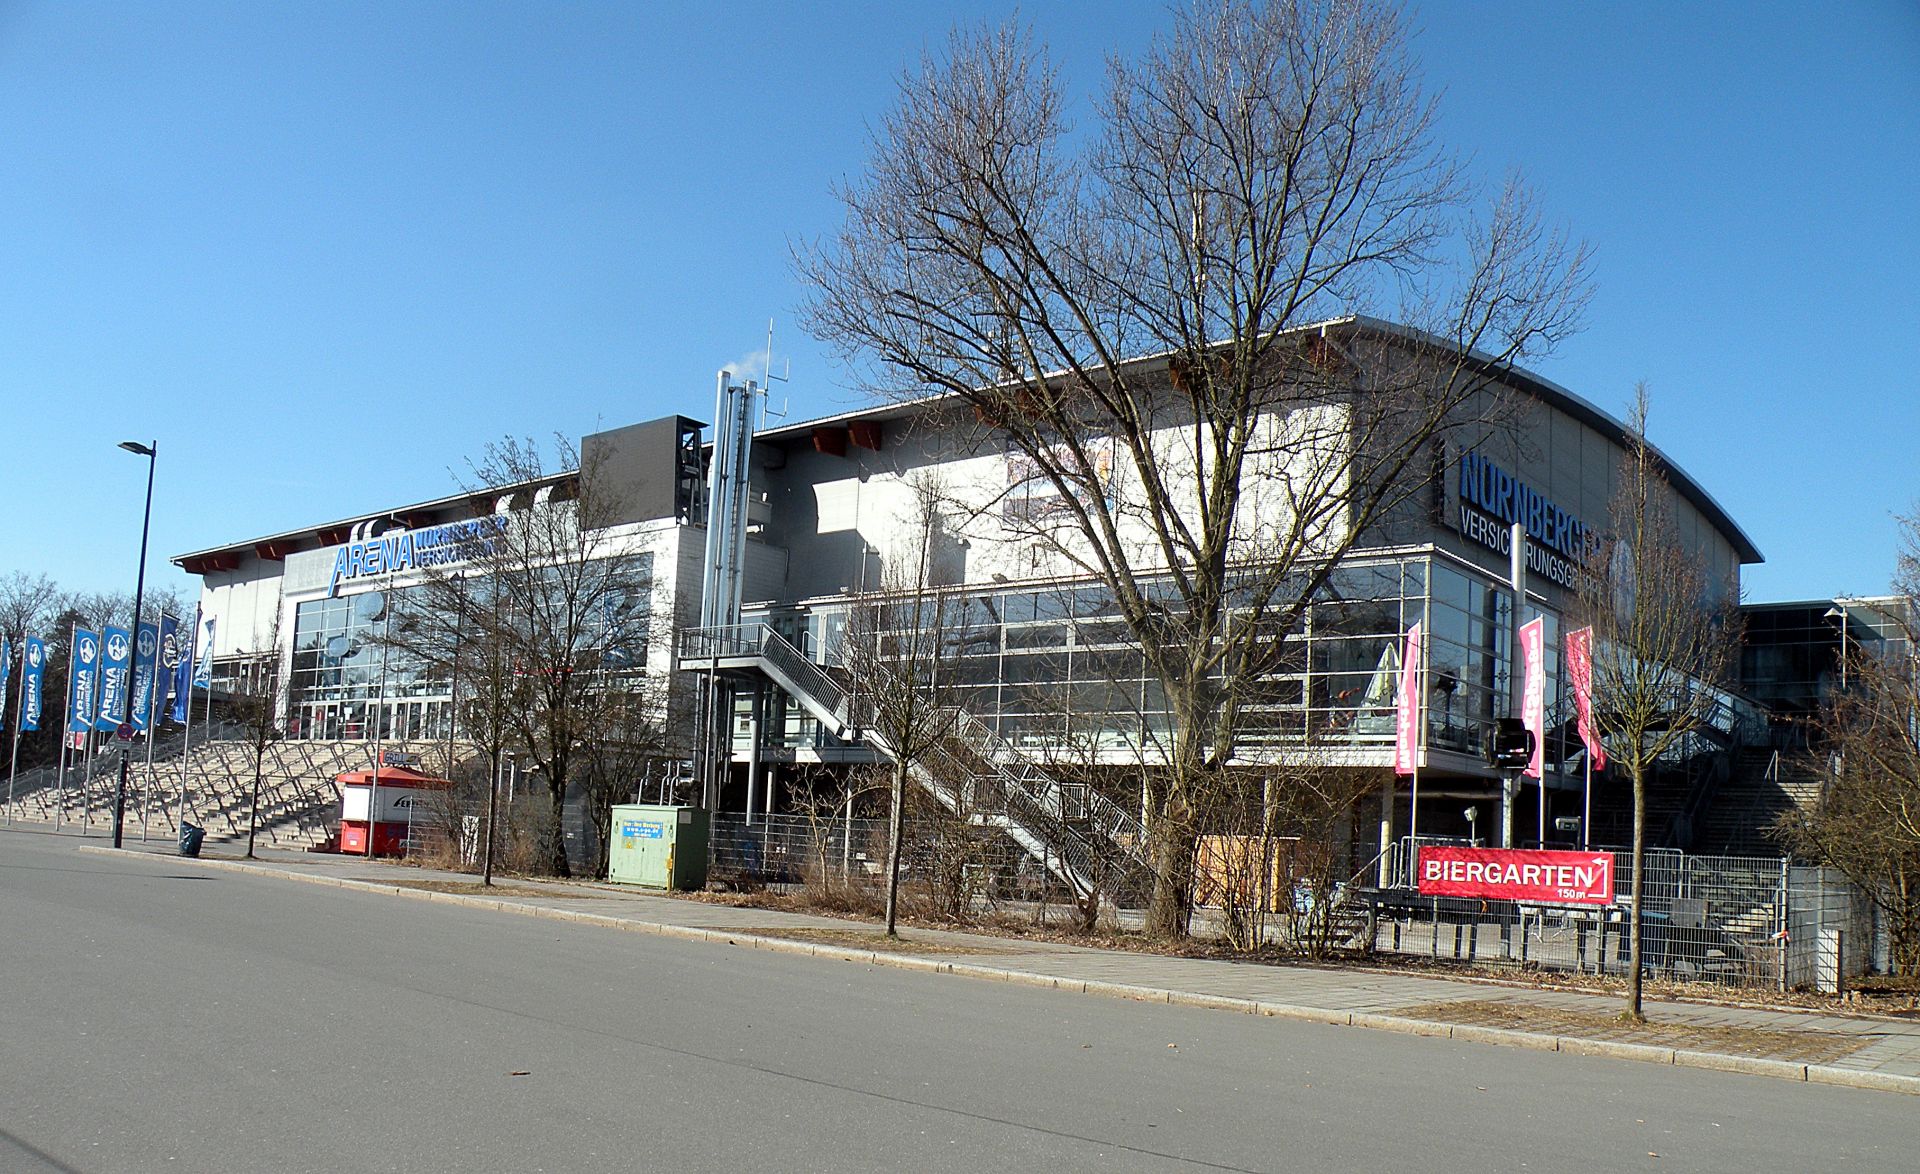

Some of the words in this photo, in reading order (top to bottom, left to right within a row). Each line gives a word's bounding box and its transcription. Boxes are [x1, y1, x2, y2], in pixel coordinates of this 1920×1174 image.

[327, 534, 413, 598] ARENA
[26, 673, 37, 725] ARENA
[76, 669, 92, 726] ARENA
[101, 667, 122, 724] ARENA
[384, 751, 405, 764] GRILL
[1425, 860, 1594, 889] BIERGARTEN
